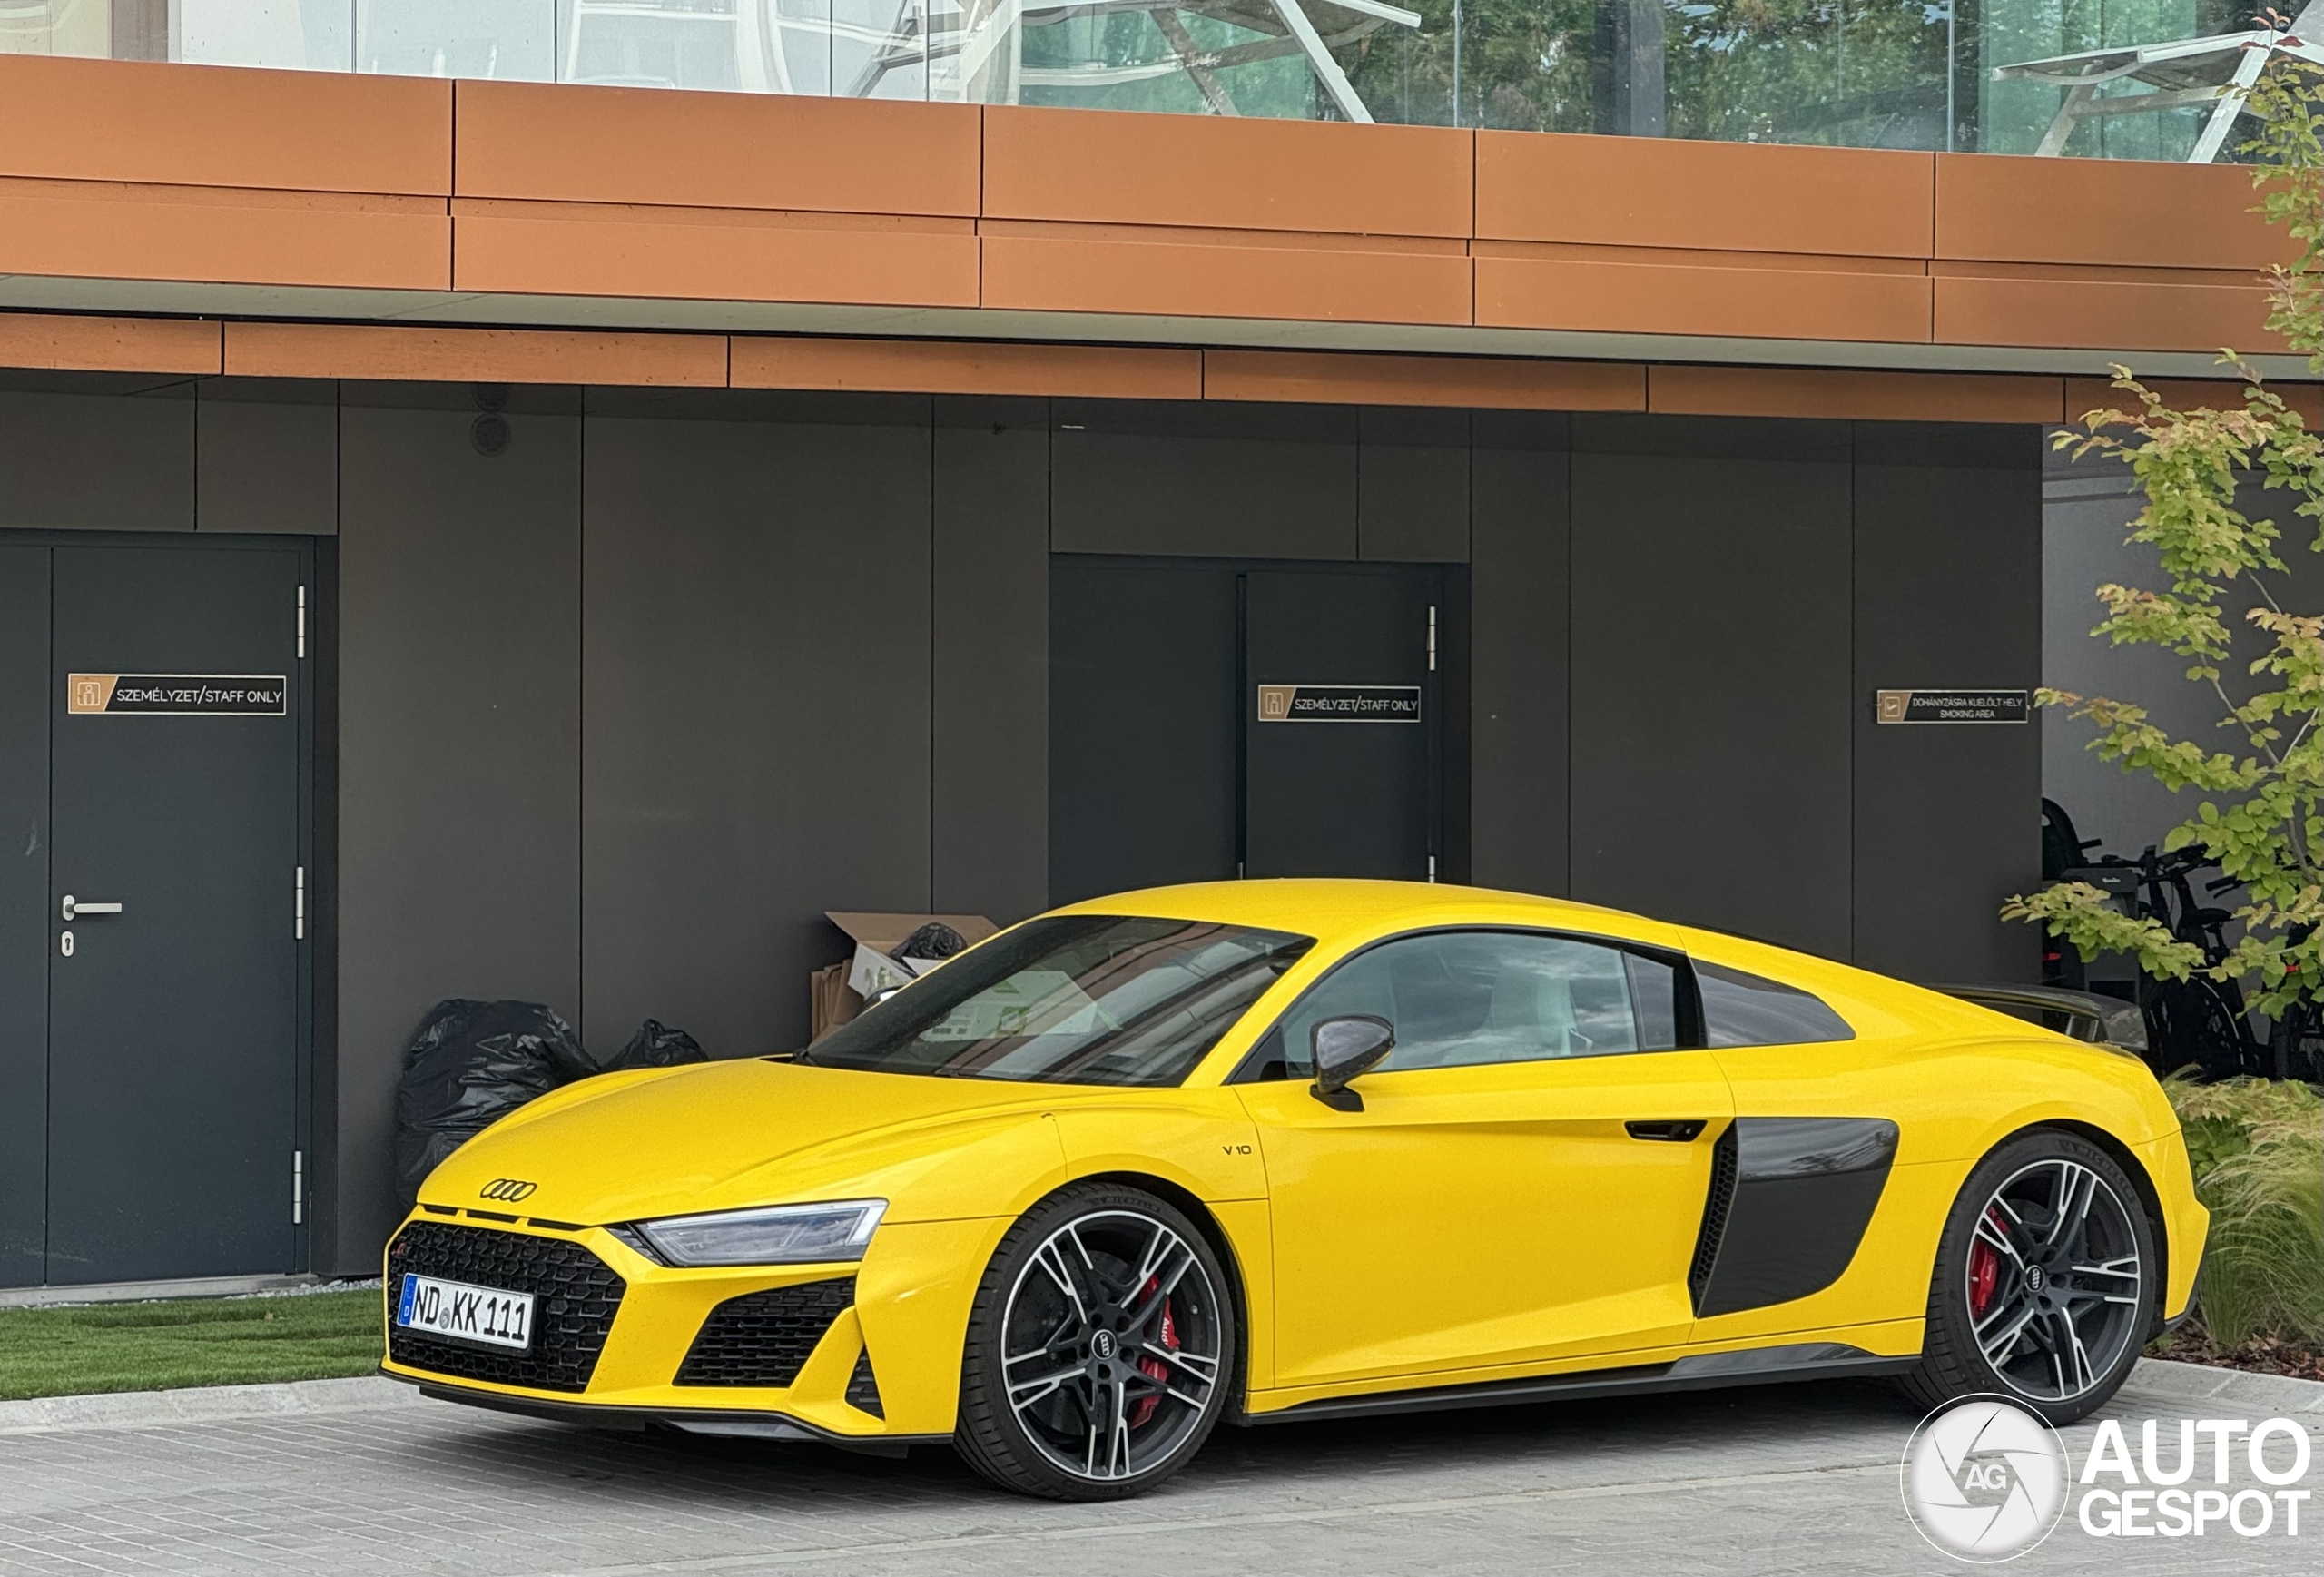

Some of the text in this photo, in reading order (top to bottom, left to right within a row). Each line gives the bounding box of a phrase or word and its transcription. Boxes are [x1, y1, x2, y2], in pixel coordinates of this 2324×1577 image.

[117, 685, 281, 705] SZEMÉLYZET/STAFF ONLY
[1295, 695, 1417, 712] SZEMÉLYZET/STAFF ONLY
[2003, 698, 2023, 707] HELY
[1940, 709, 1995, 718] SMOKING AREA
[412, 1284, 526, 1342] ND KK 111
